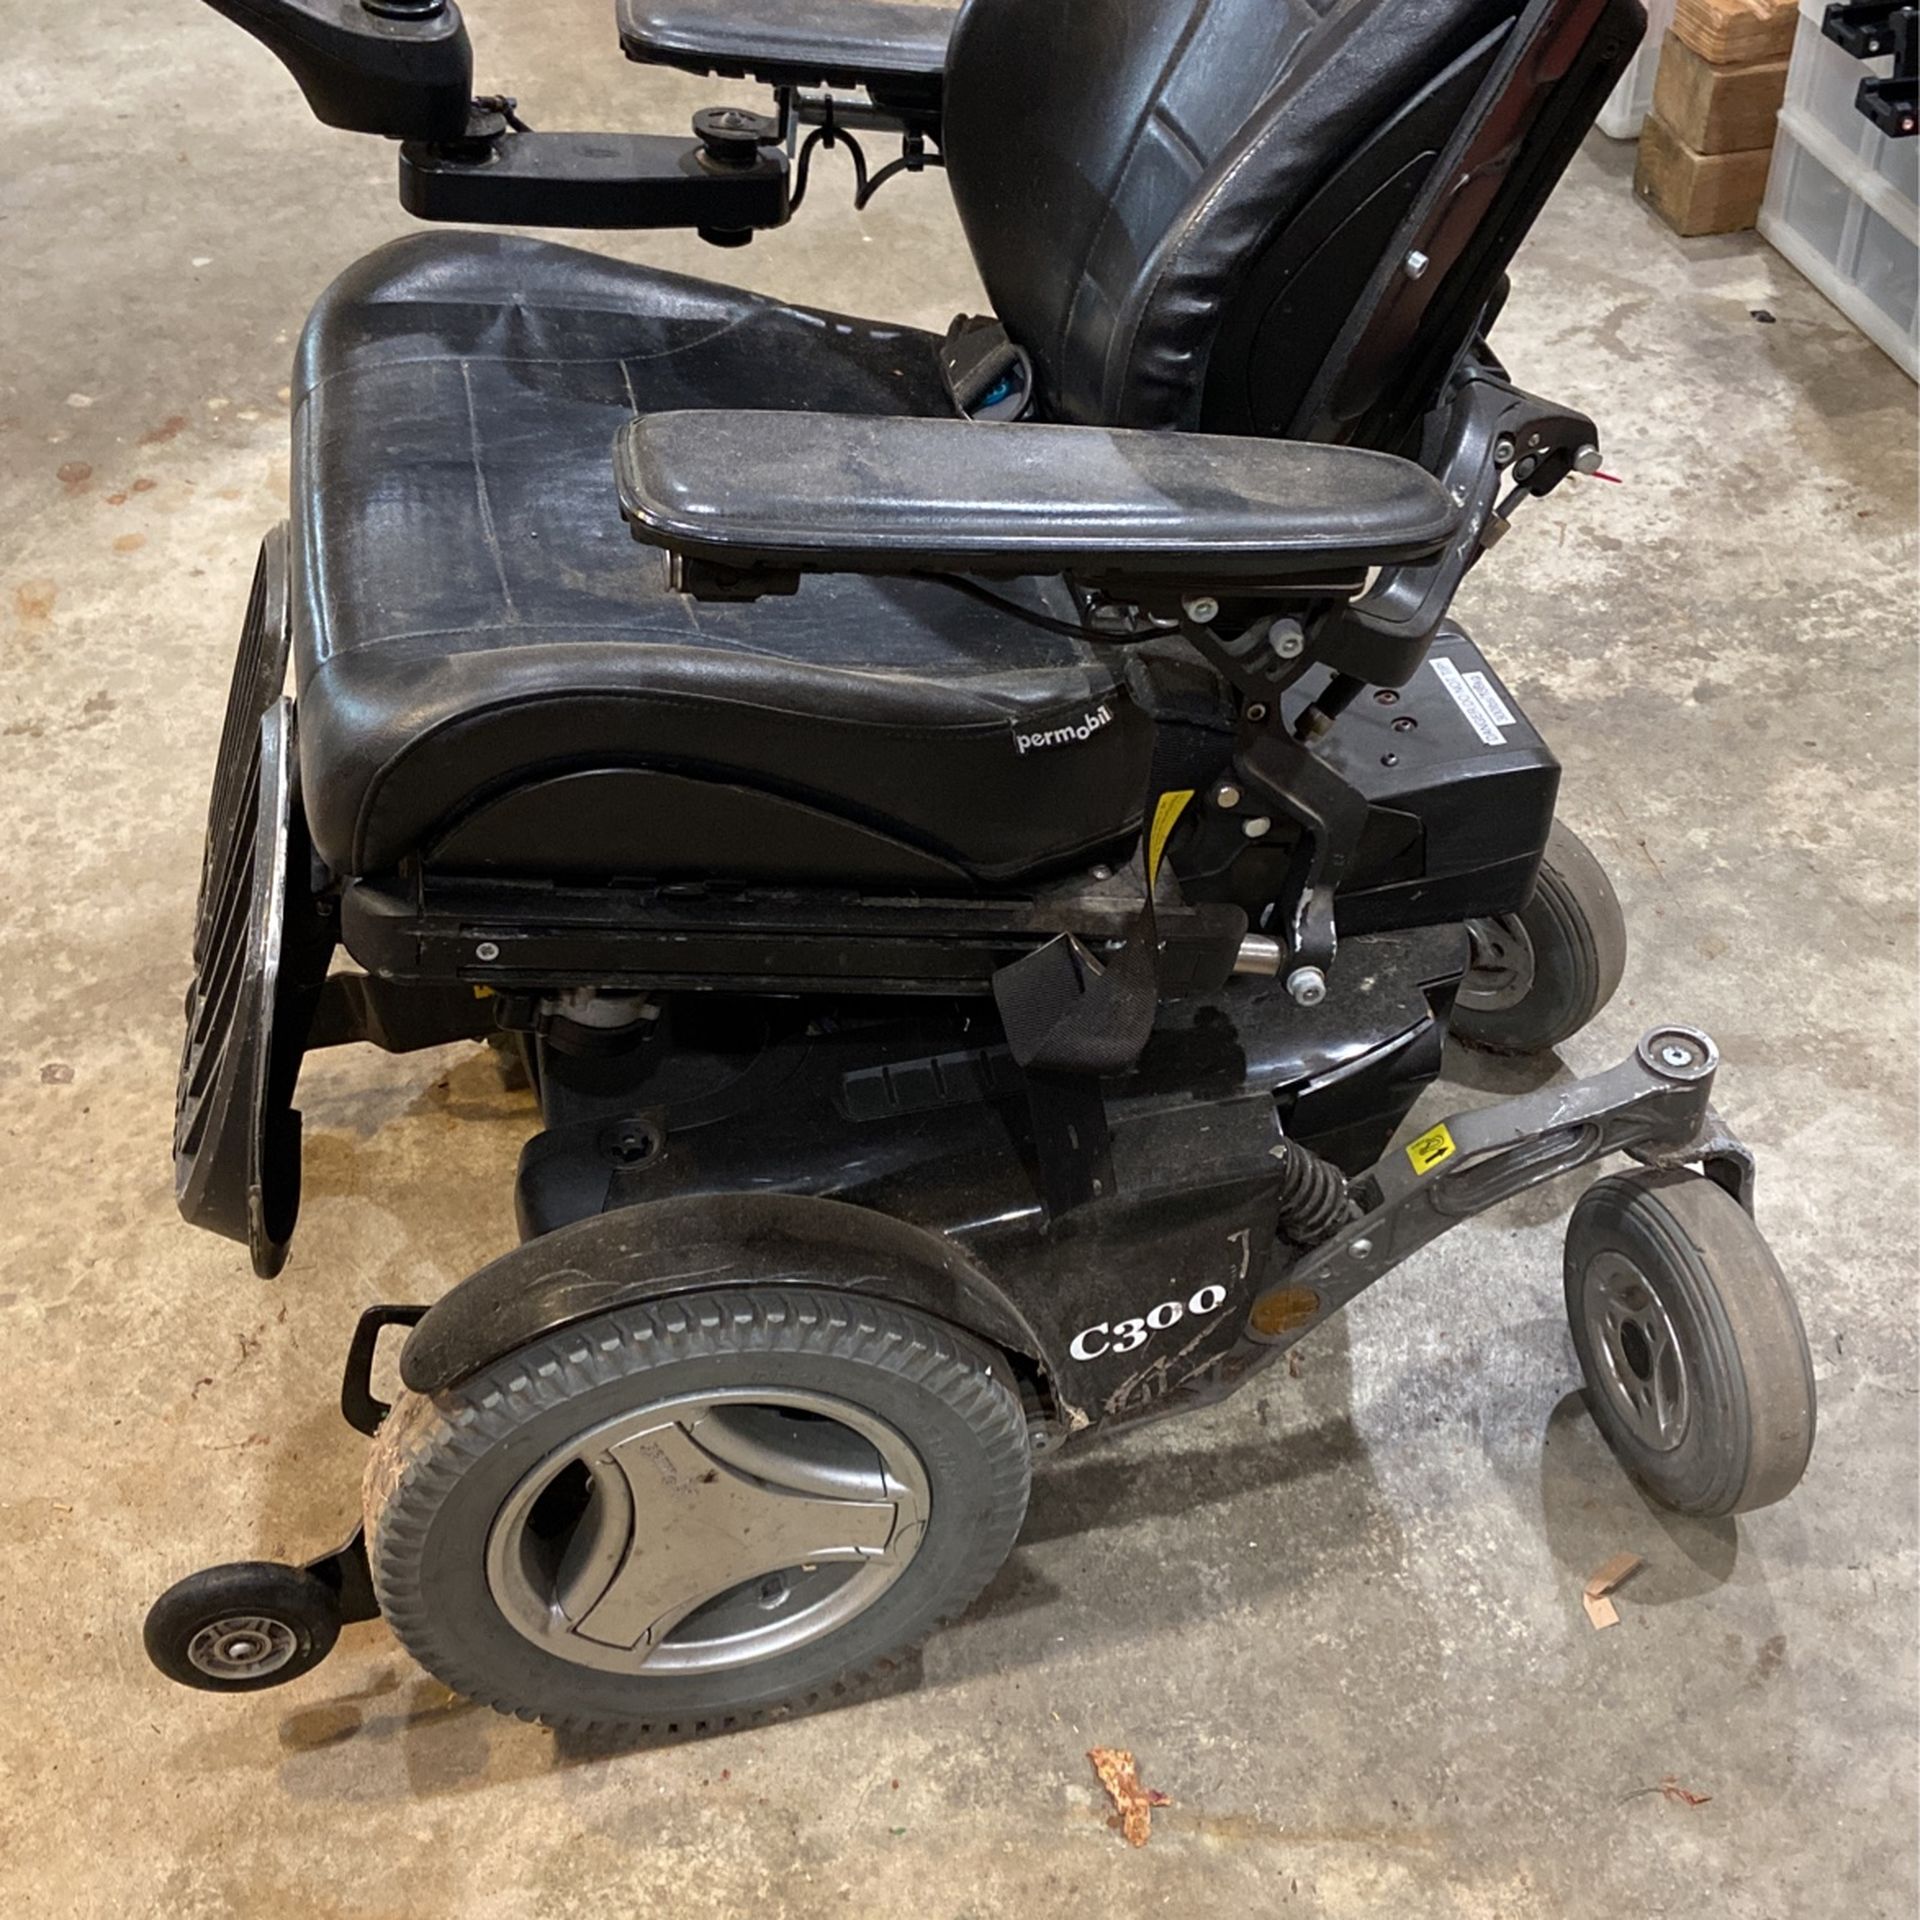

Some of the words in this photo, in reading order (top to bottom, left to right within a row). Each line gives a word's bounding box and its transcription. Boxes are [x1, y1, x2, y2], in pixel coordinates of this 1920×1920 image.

[1444, 677, 1463, 694] NOT
[1457, 694, 1475, 708] DO
[1016, 704, 1114, 754] permobil
[1466, 707, 1499, 742] DANGER
[1069, 1284, 1227, 1361] C300
